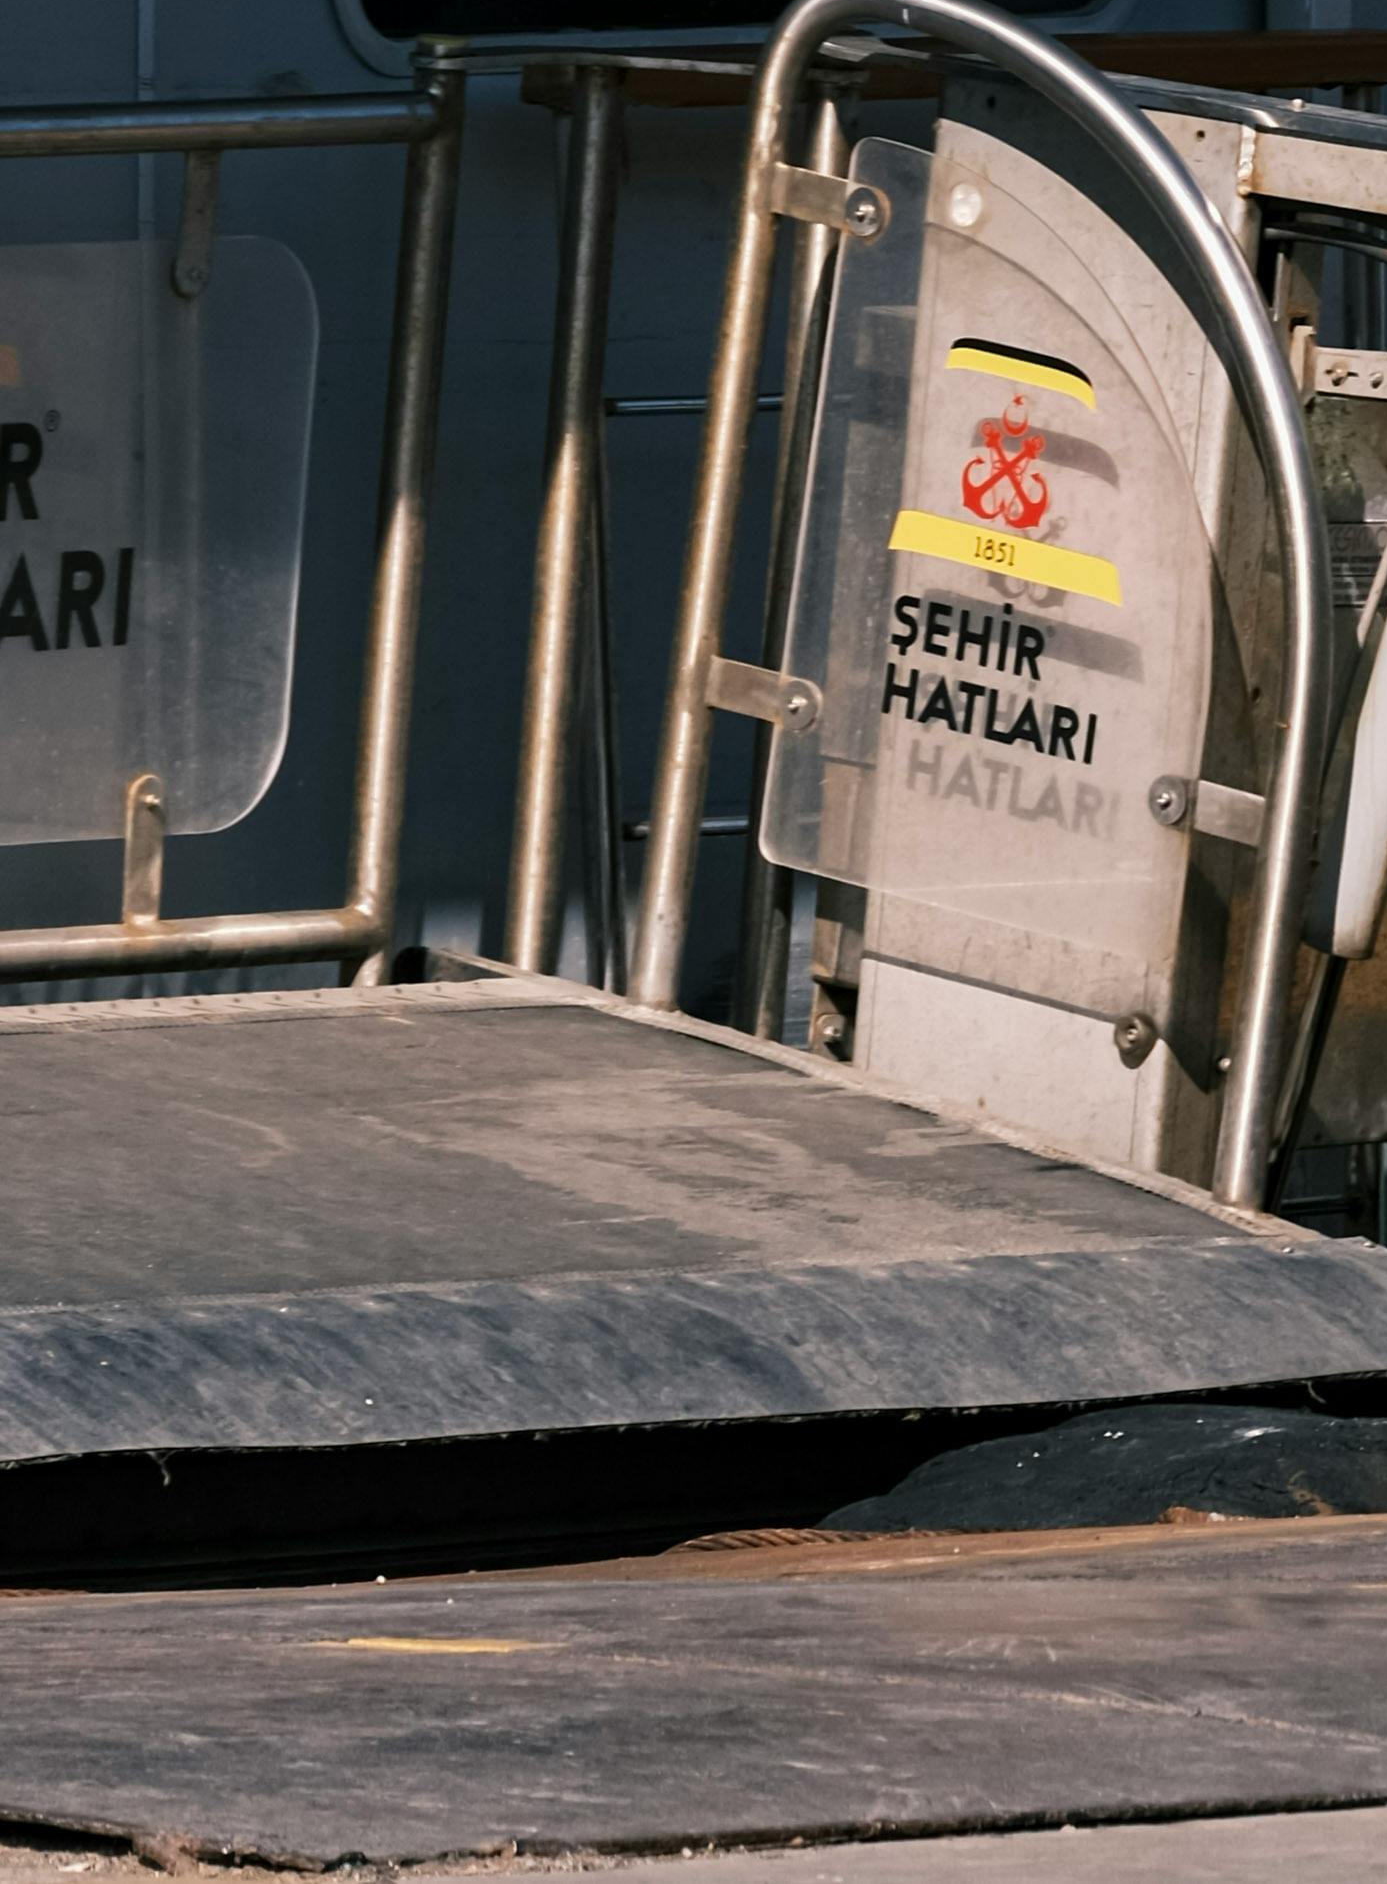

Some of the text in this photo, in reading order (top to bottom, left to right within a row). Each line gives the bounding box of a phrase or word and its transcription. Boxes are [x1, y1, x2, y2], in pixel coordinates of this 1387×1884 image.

[974, 536, 1016, 567] 1851
[891, 595, 1045, 681] ŞEHİR
[881, 662, 1098, 765] HATLARI
